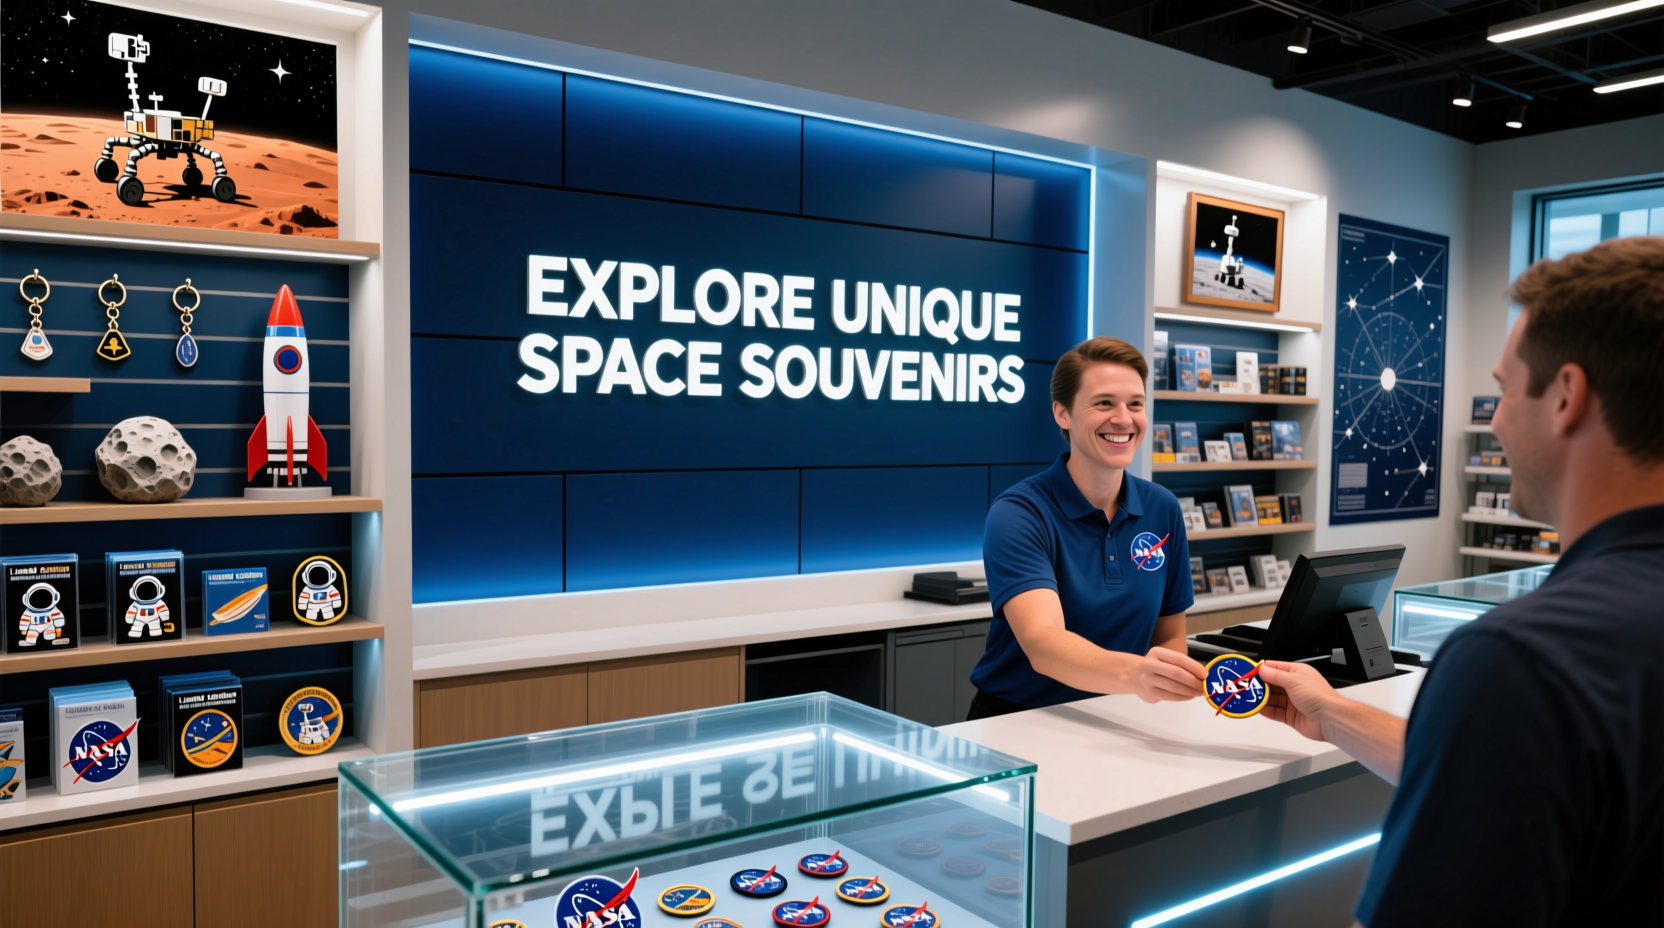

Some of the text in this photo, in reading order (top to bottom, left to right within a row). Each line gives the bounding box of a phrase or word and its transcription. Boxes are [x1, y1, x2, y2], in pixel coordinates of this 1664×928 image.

[527, 254, 1021, 345] EXPLORE UNIQUE
[517, 332, 1026, 404] SPACE SOUVENIRS
[1211, 676, 1263, 694] NASA
[75, 742, 128, 760] NASA
[563, 903, 637, 928] NASA
